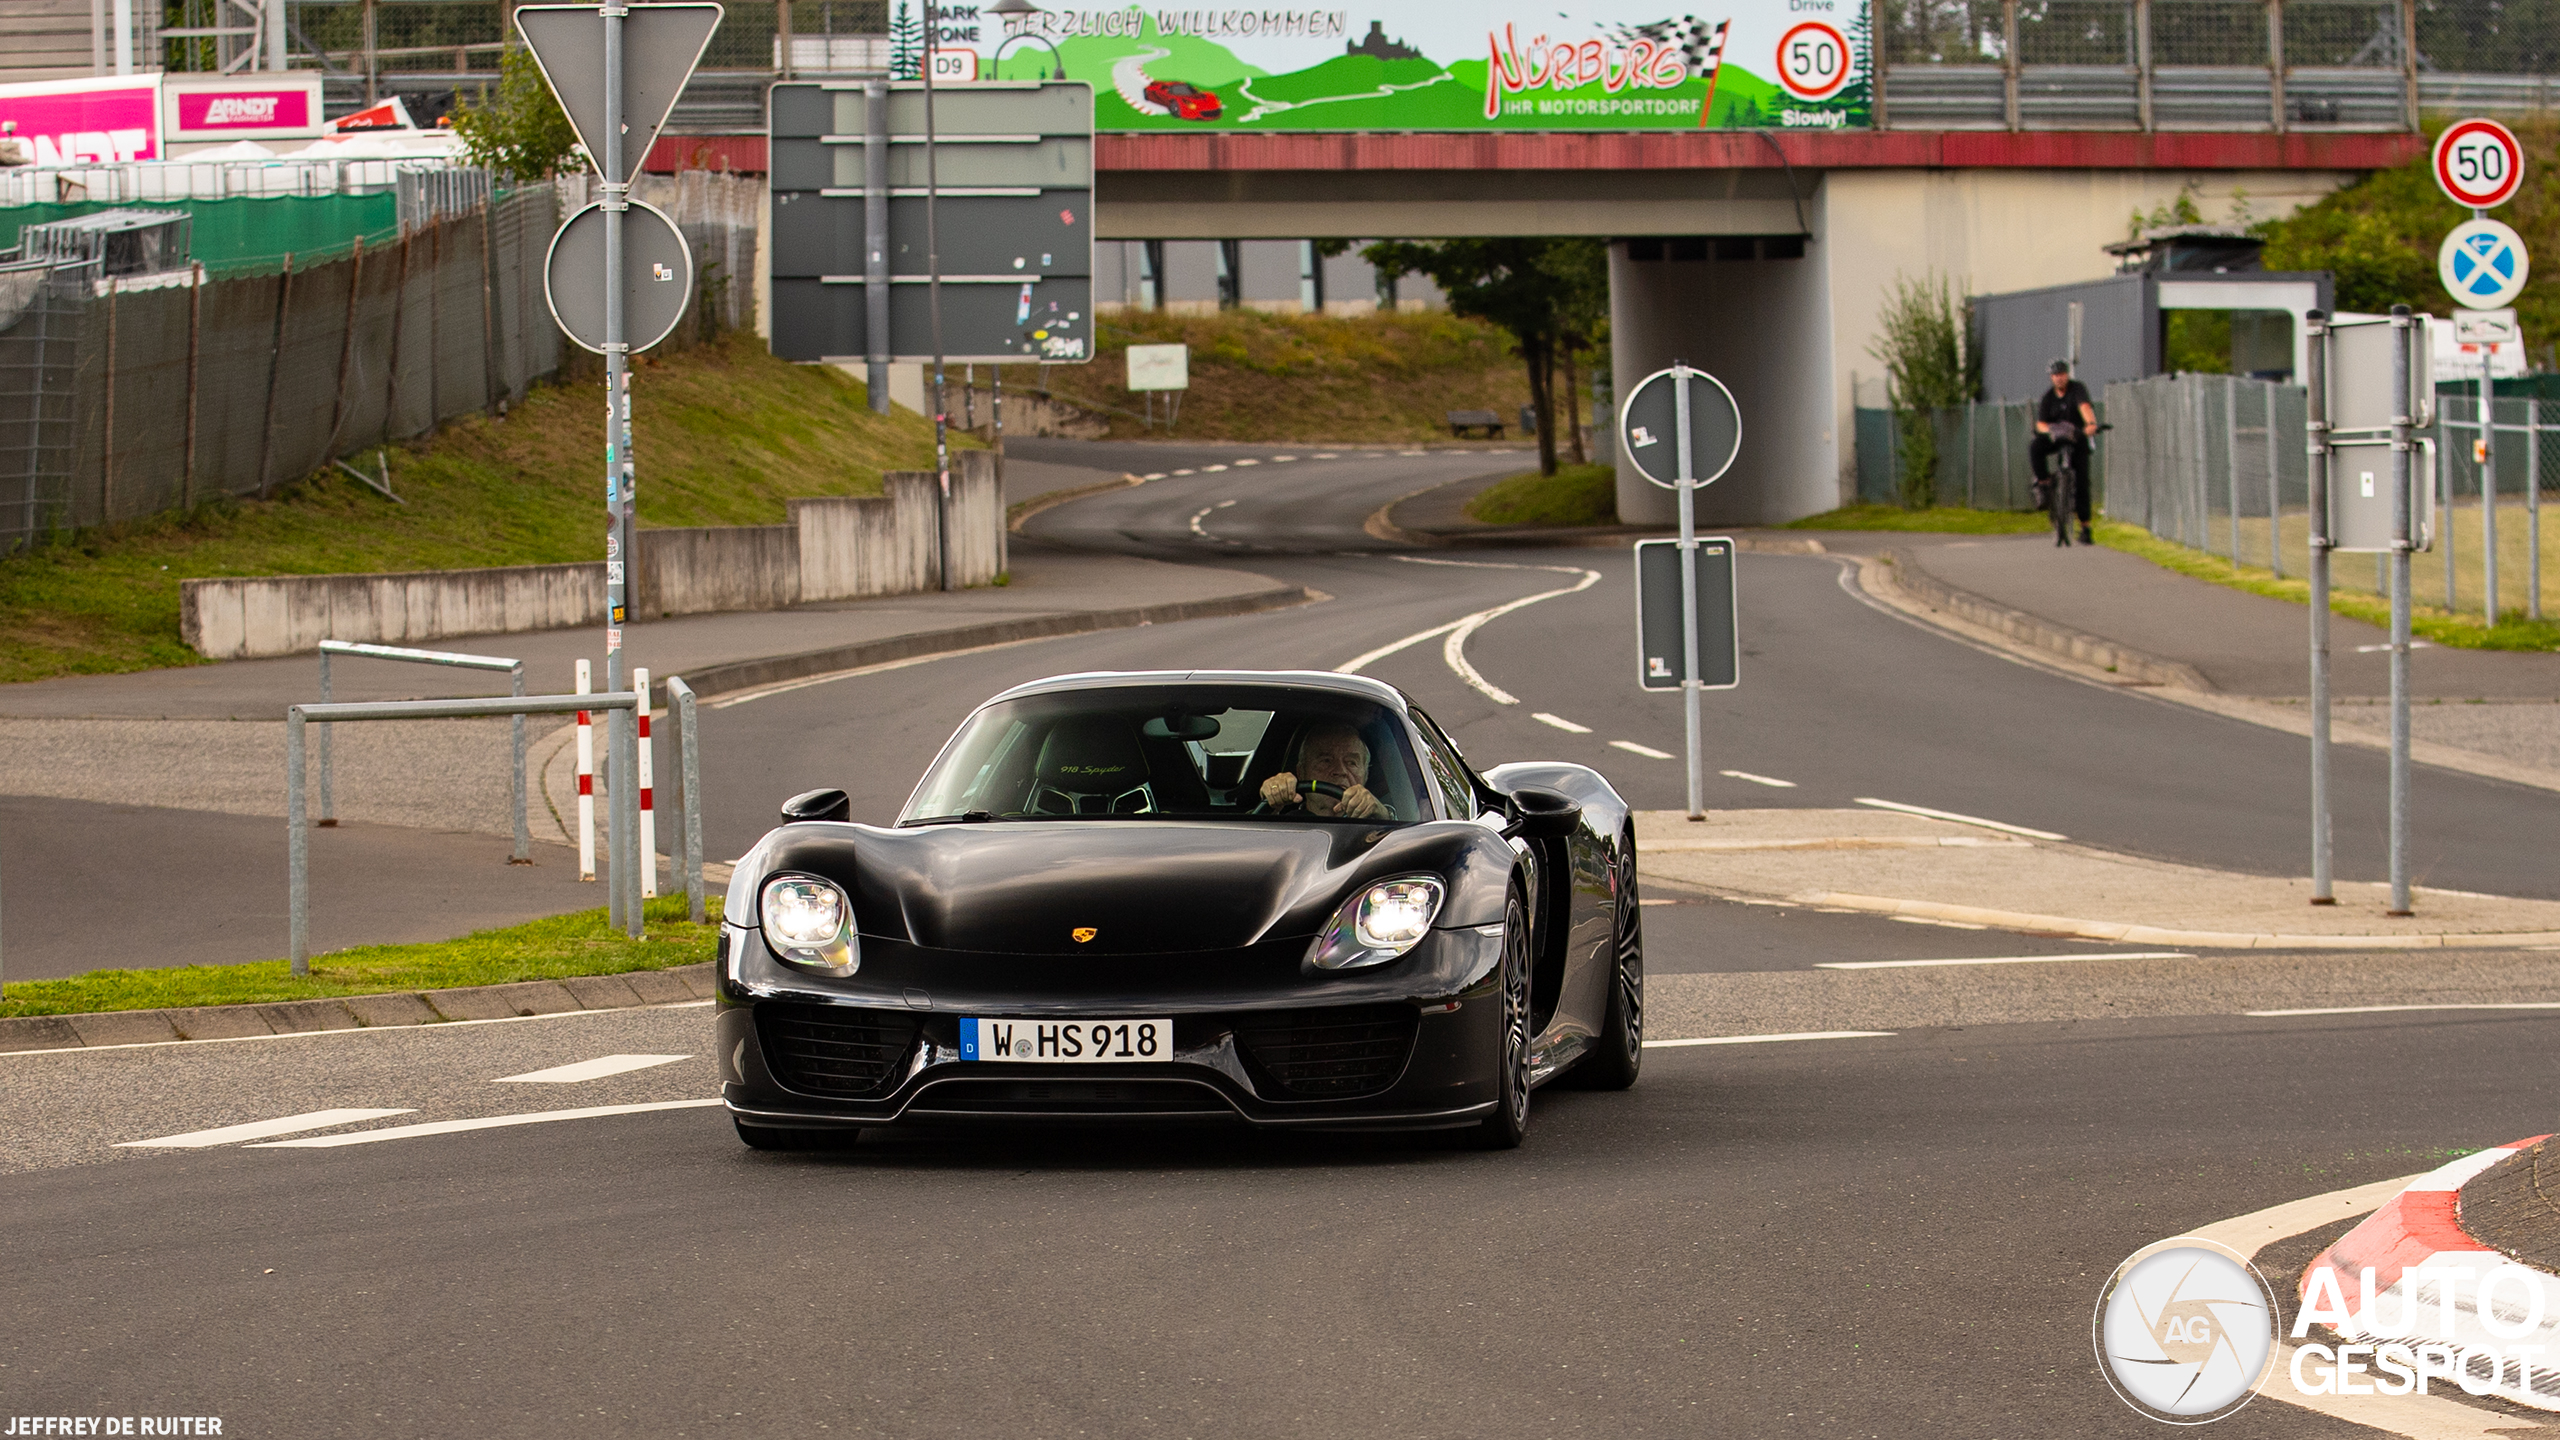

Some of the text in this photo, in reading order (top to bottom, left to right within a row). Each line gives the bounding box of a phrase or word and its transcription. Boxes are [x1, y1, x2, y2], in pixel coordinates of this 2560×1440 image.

[935, 5, 980, 20] ARK
[1789, 0, 1835, 11] Drive
[1156, 9, 1347, 38] WILLKOMMEN
[935, 26, 980, 42] ONE
[936, 57, 962, 74] D9
[1793, 42, 1834, 75] 50
[1485, 22, 1688, 119] NÜRBURG
[204, 97, 279, 124] ARNDT
[1503, 99, 1700, 115] IHR MOTORSPORTDORF
[1781, 109, 1847, 130] Slowly!
[2457, 145, 2503, 181] 50
[1060, 765, 1126, 776] 918 Spyder
[966, 1043, 974, 1053] D
[992, 1023, 1158, 1058] W HS 918
